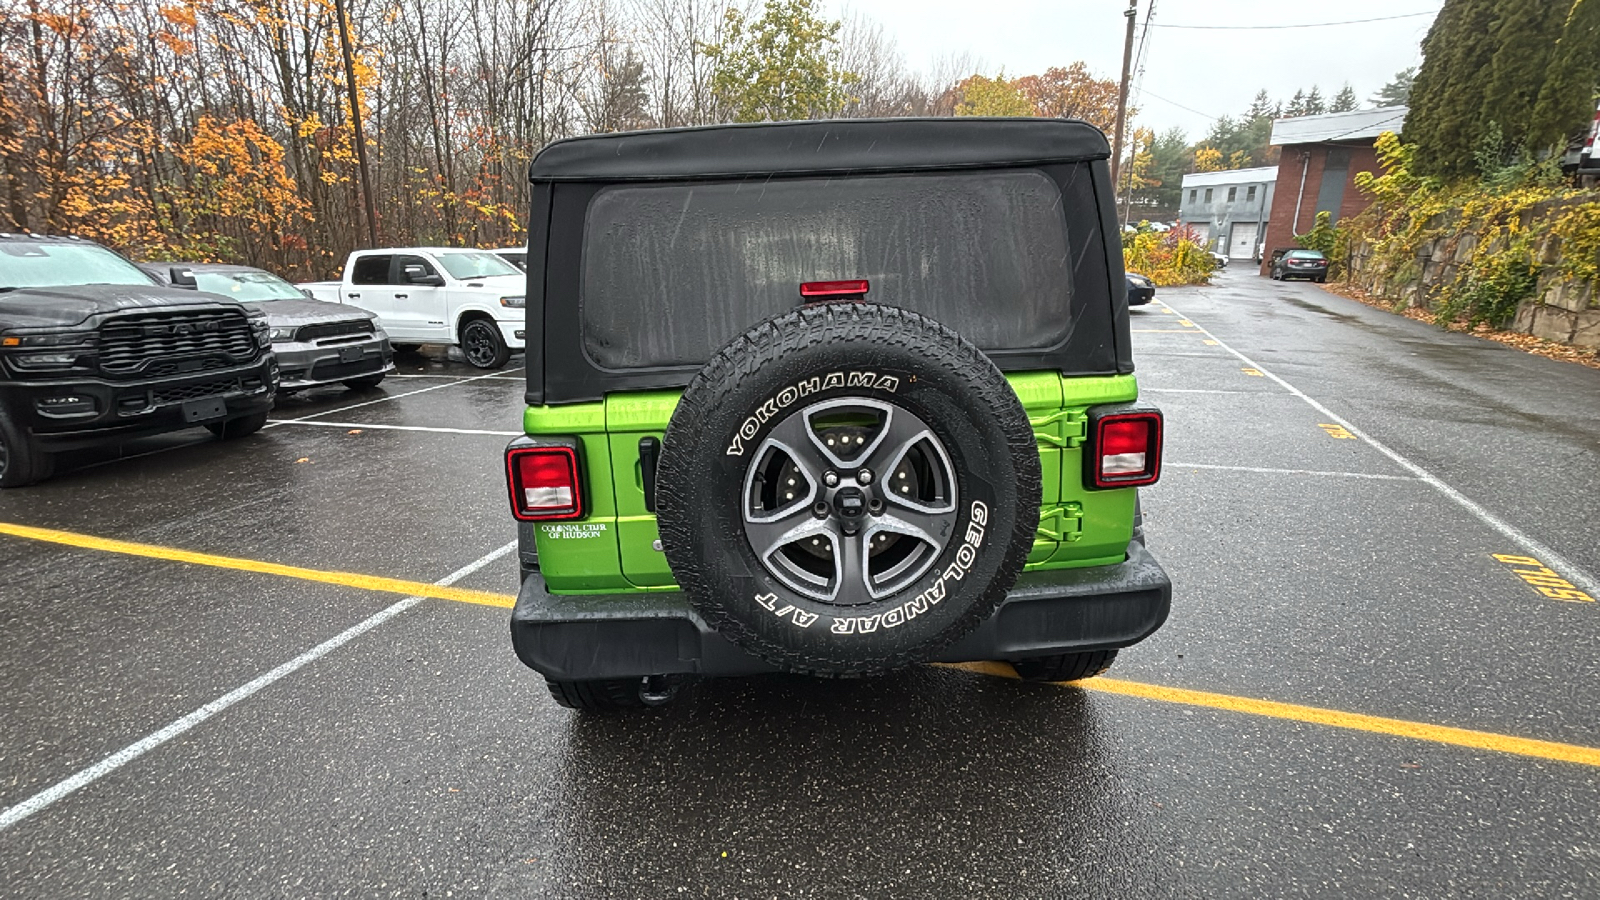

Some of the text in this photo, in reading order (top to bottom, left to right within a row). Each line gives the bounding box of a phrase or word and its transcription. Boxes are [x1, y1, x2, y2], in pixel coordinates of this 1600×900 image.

[726, 371, 899, 456] YOKOHAMA
[541, 524, 581, 532] COLONIAL
[563, 531, 600, 539] HUDSON
[754, 500, 988, 635] GEOLANDAR A/T
